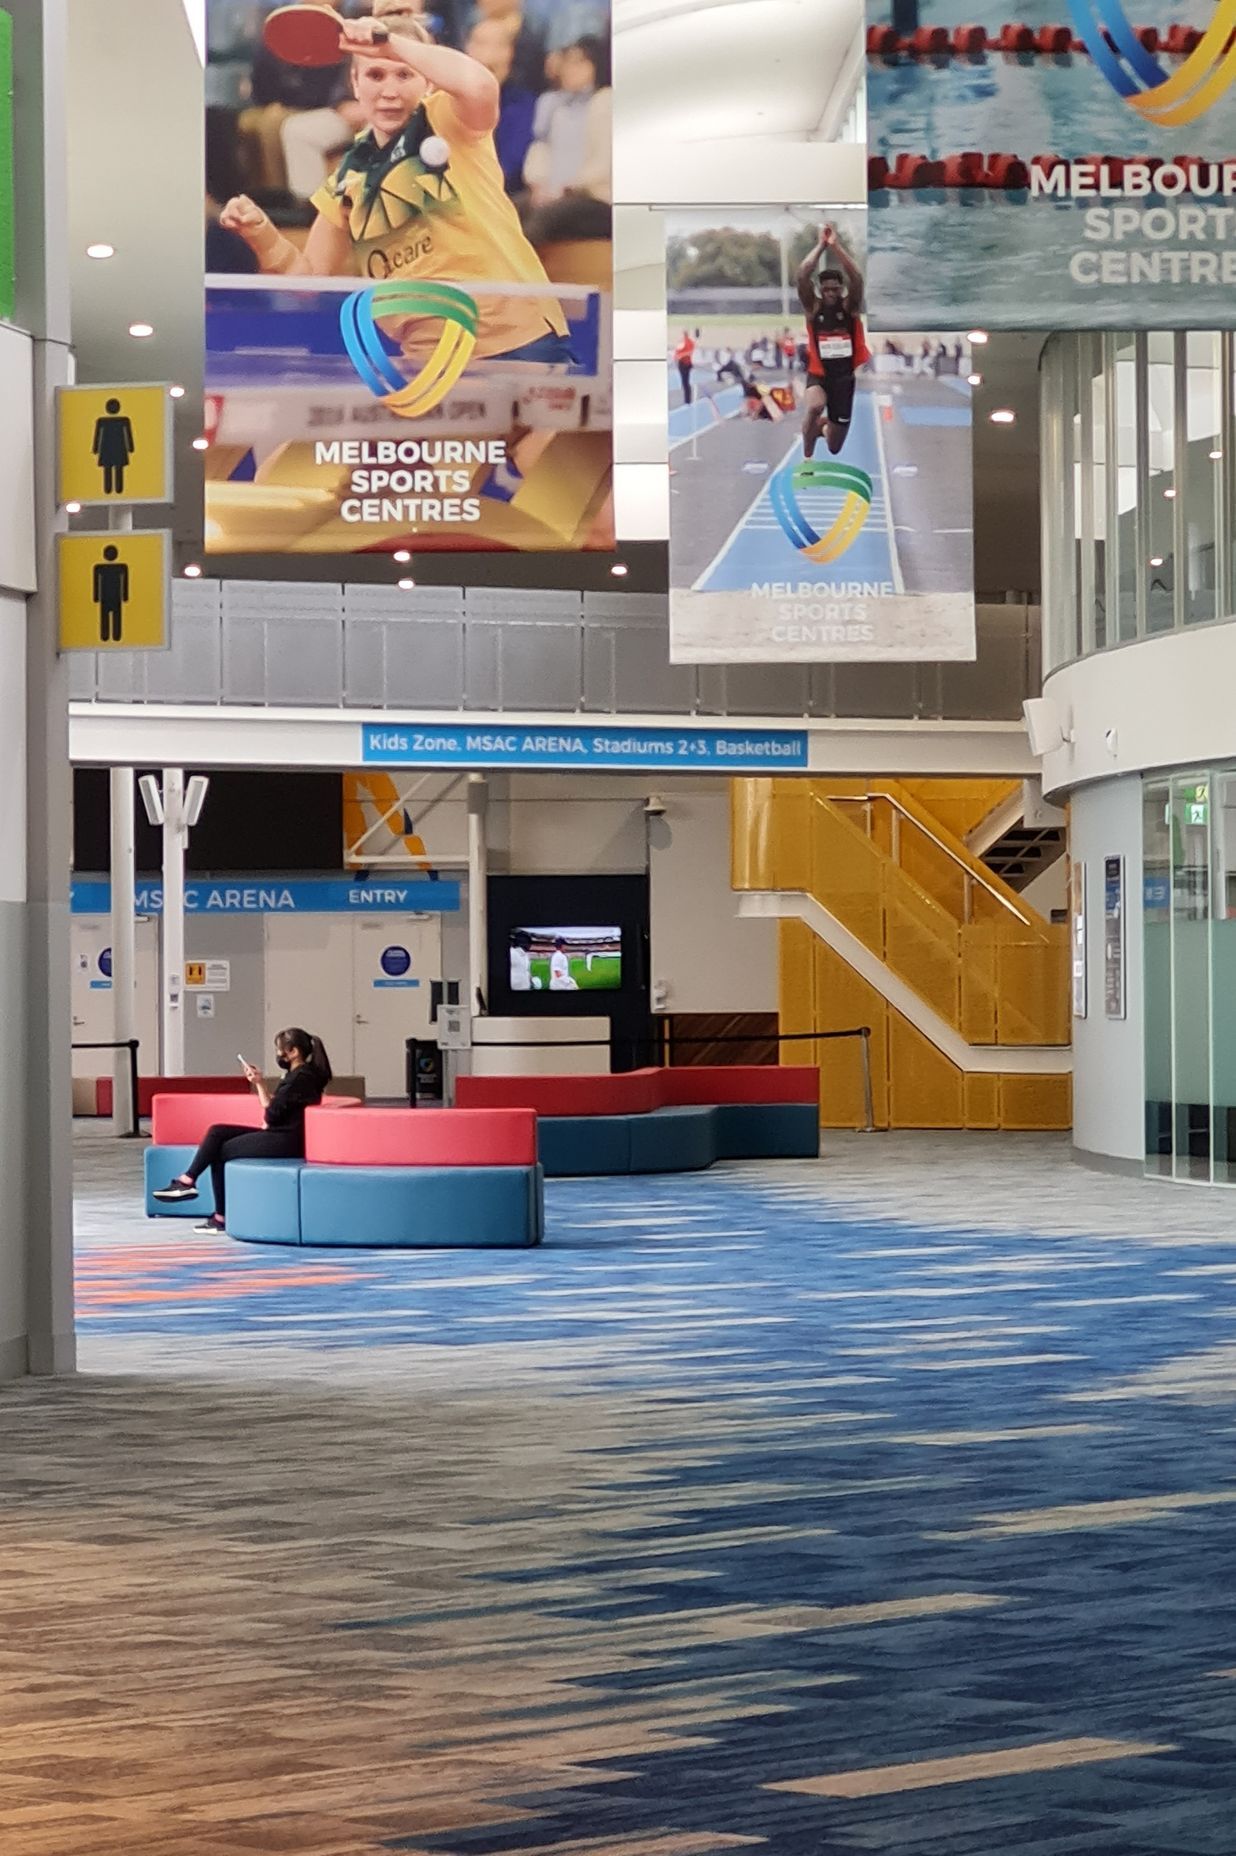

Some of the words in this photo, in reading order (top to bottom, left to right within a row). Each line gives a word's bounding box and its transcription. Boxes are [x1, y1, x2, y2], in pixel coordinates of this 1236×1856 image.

[1084, 208, 1236, 240] SPORT
[315, 440, 507, 465] MELBOURNE
[351, 470, 470, 493] SPORTS
[340, 498, 480, 522] CENTRES
[751, 582, 894, 598] MELBOURNE
[777, 603, 867, 621] SPORTS
[772, 625, 873, 642] CENTRES
[369, 734, 408, 751] Kids
[466, 735, 517, 752] MSAC
[592, 737, 674, 754] Stadiums
[716, 739, 801, 757] Basketball
[134, 889, 199, 909] MSC
[205, 889, 296, 909] ARENA
[348, 889, 409, 904] ENTRY
